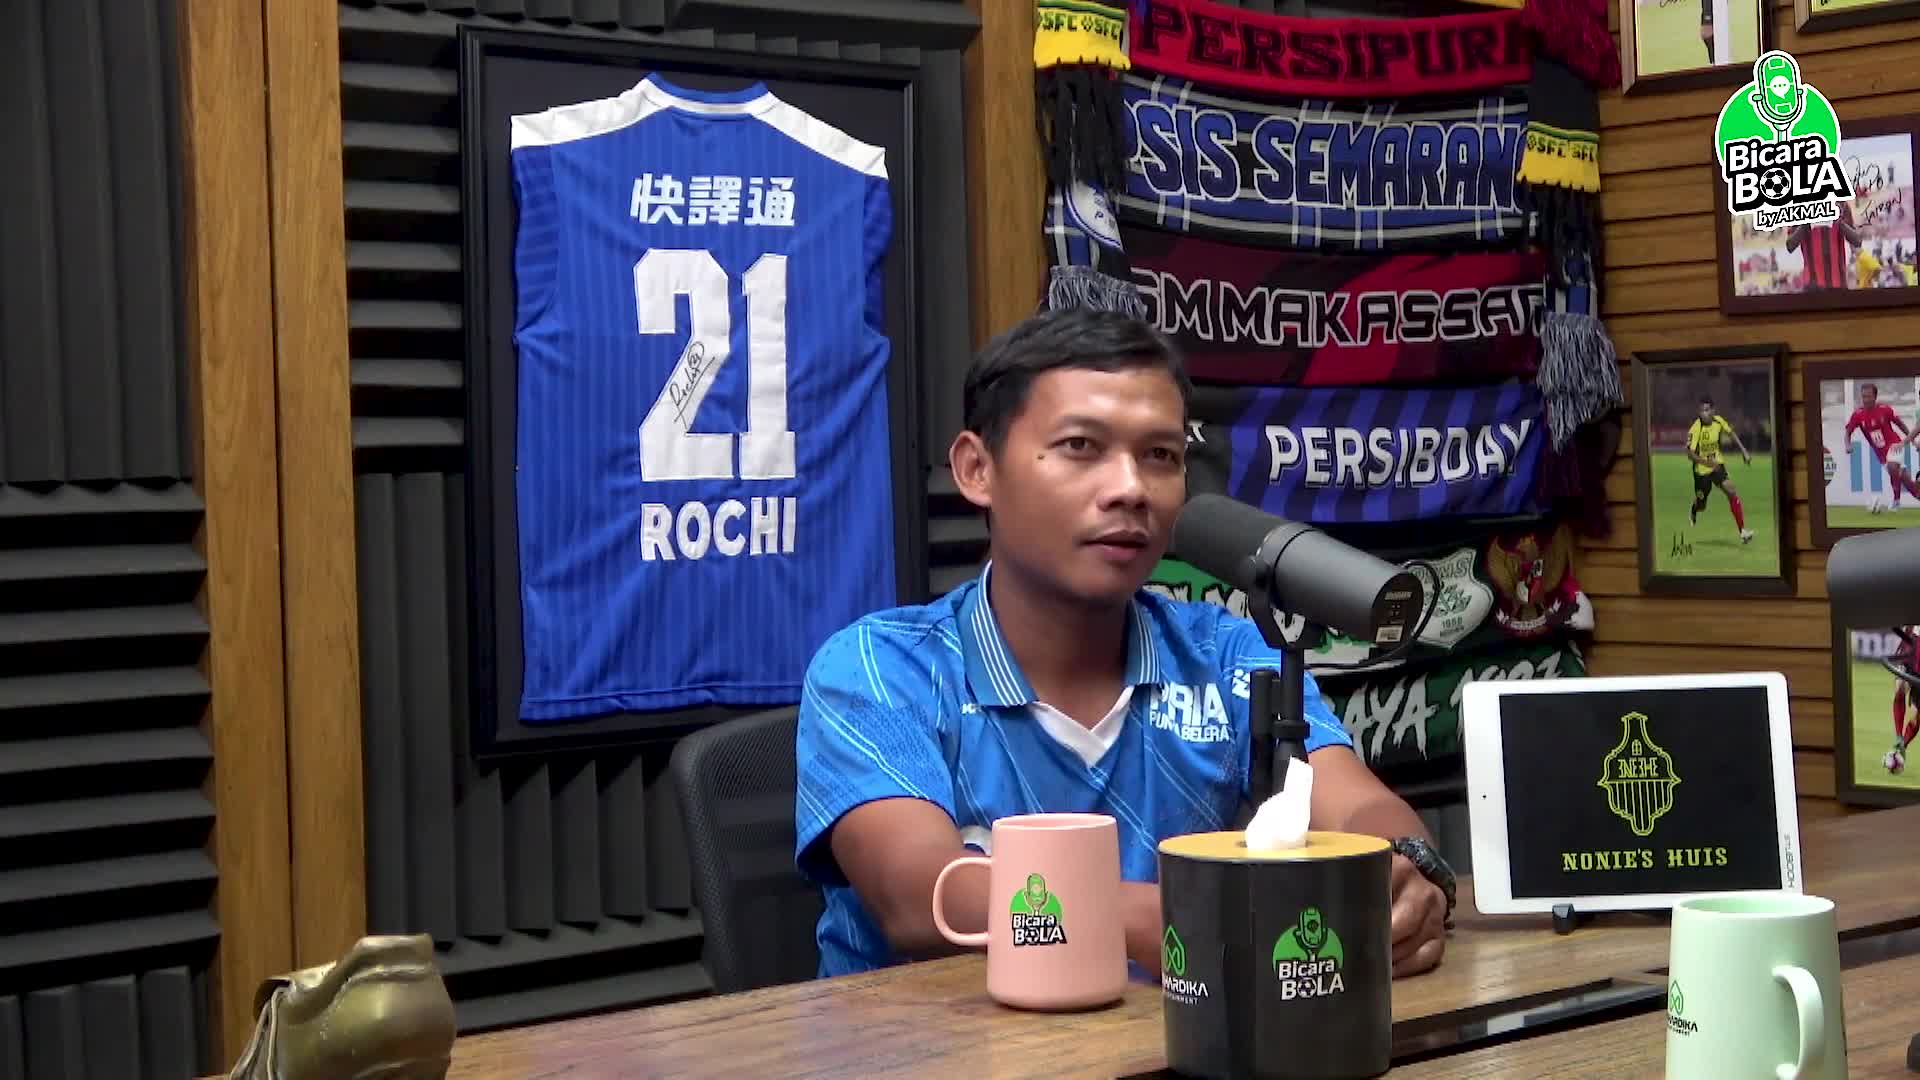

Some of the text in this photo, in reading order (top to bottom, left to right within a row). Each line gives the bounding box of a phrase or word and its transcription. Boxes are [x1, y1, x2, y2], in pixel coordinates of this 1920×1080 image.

[630, 172, 797, 228] 快譯通
[633, 247, 797, 482] 21
[640, 496, 798, 562] ROCHI
[1323, 672, 1439, 766] AYA
[1562, 847, 1728, 871] NONIE'S HUIS
[1013, 914, 1056, 929] Bicara
[1014, 926, 1065, 945] BOLA
[1279, 959, 1335, 980] Bicara
[1281, 972, 1345, 1000] BOLA
